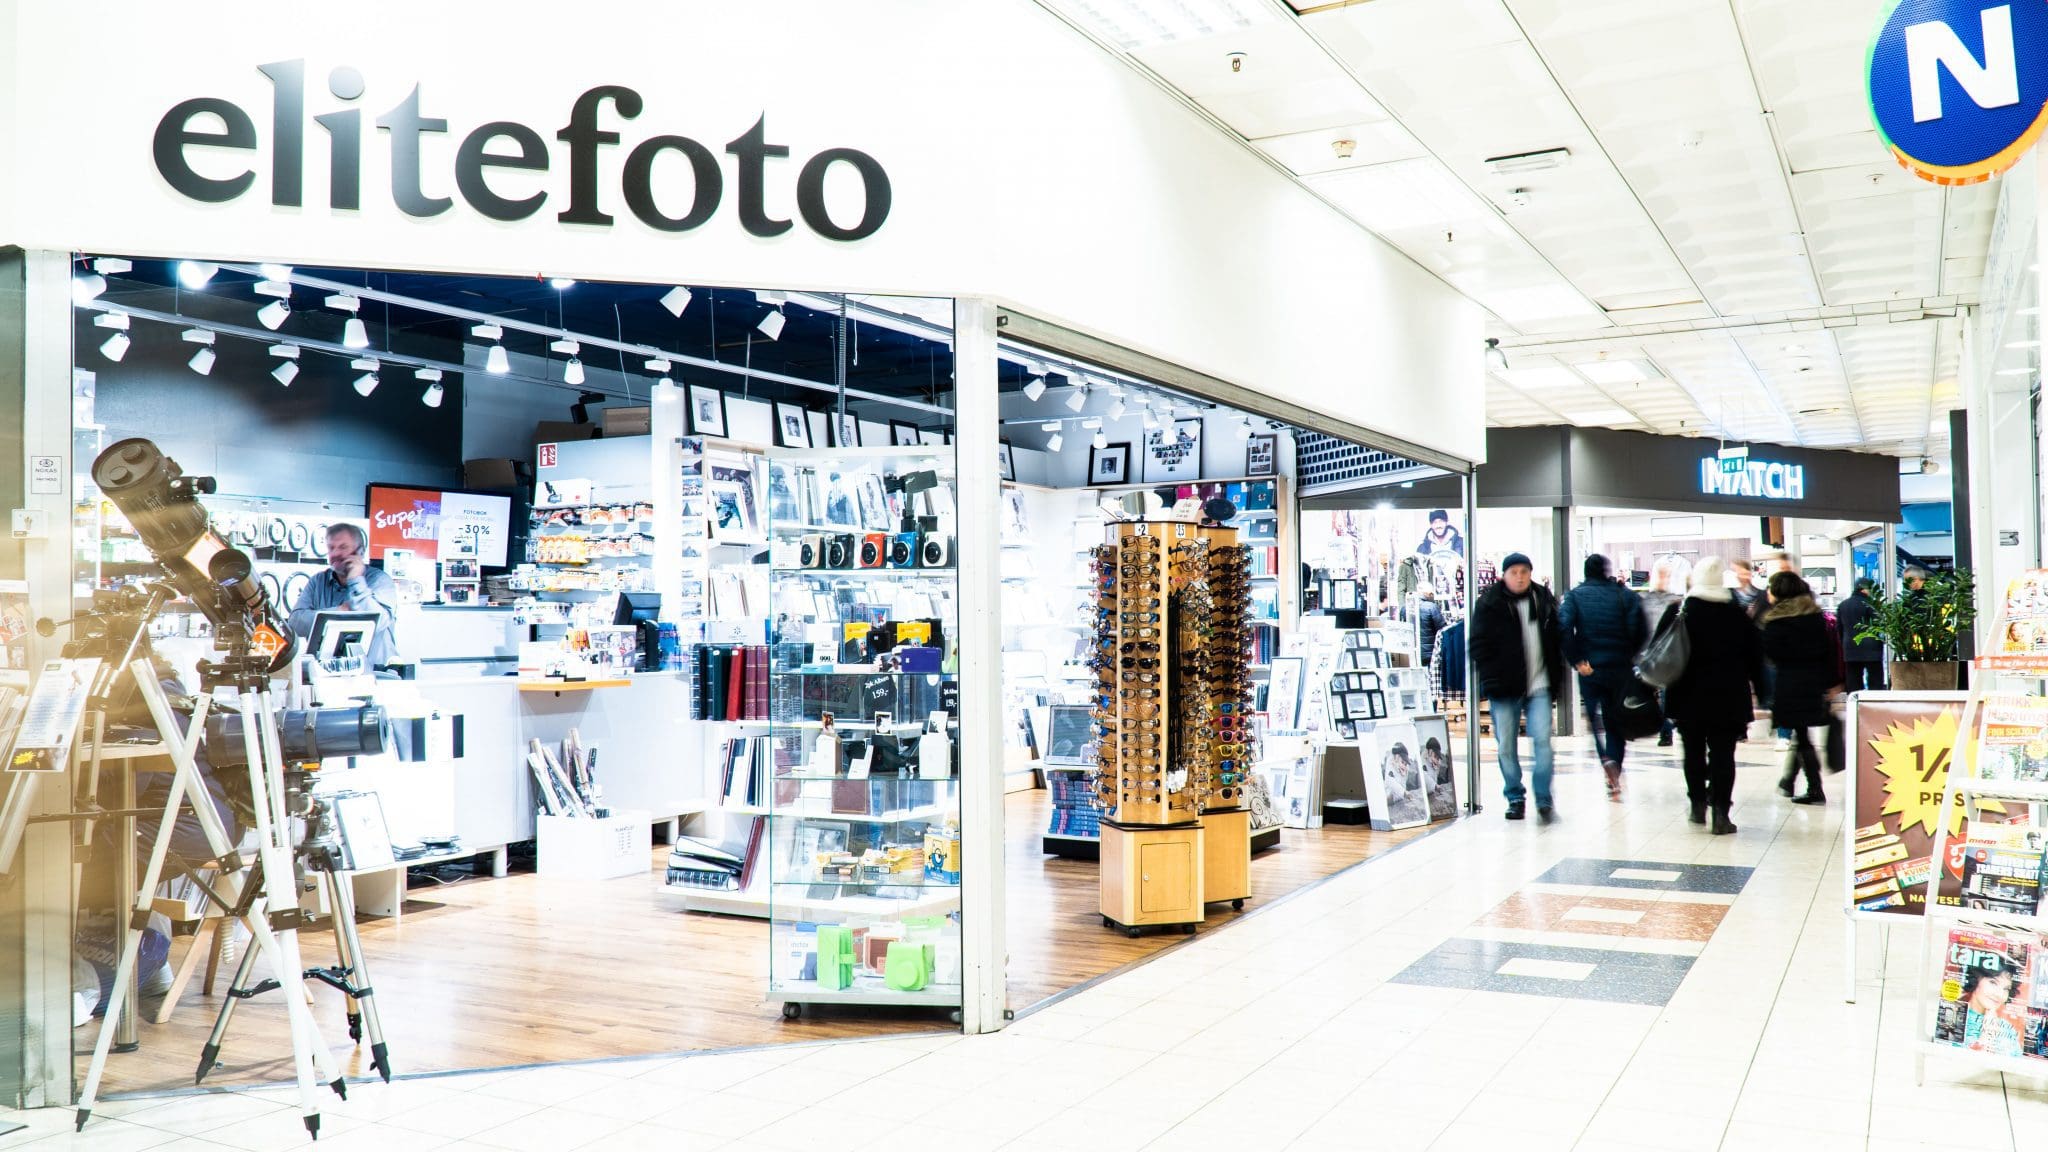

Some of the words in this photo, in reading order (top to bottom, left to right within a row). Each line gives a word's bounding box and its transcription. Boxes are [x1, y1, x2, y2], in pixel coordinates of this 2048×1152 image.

[1904, 4, 2020, 124] N
[152, 57, 893, 243] elitefoto
[1701, 456, 1804, 499] MATCH
[375, 508, 426, 530] Super
[458, 524, 491, 535] -30%
[872, 688, 889, 699] 159,-
[1919, 791, 1966, 807] PRS
[1950, 942, 2000, 971] tara
